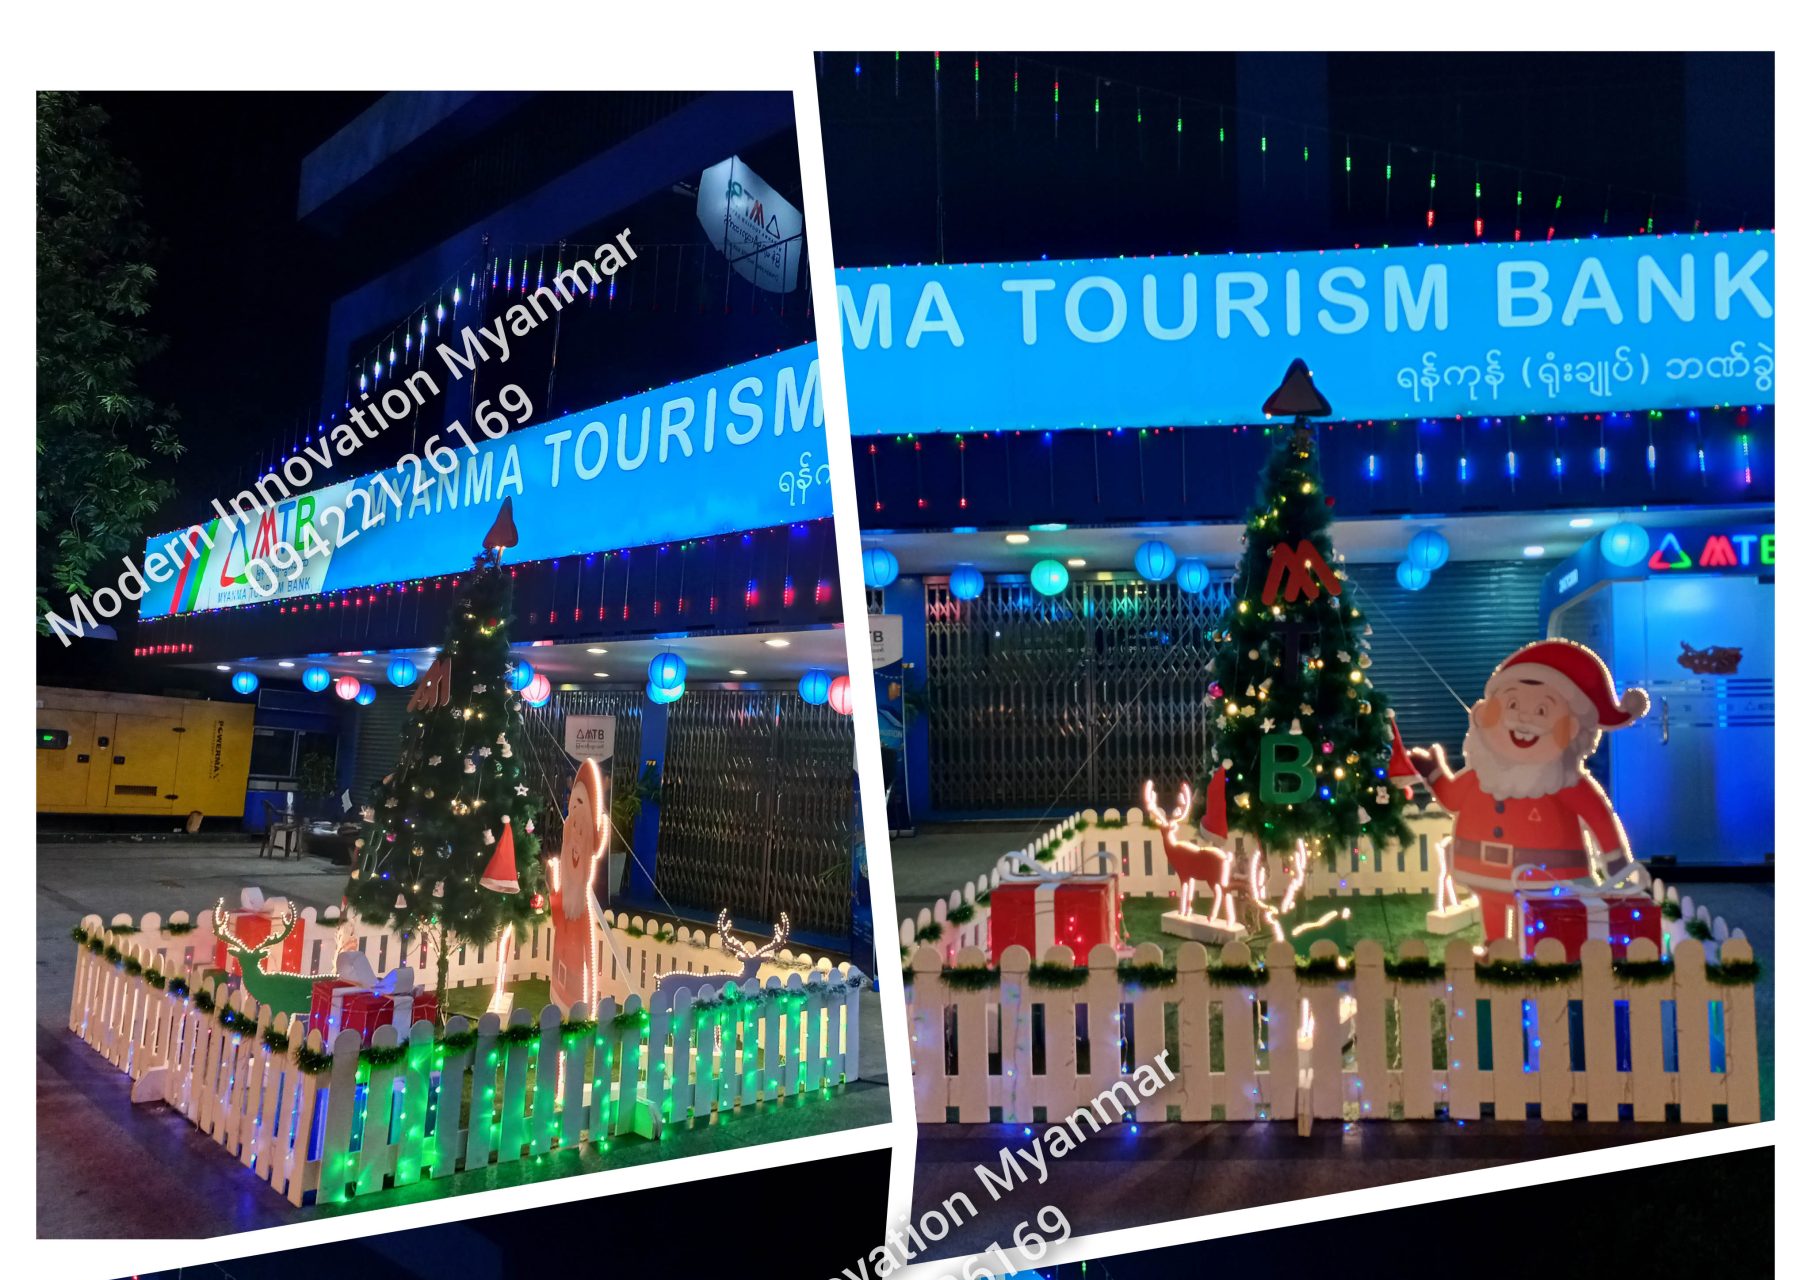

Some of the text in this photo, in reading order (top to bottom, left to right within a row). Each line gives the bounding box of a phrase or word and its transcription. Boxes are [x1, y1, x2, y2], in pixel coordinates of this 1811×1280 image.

[836, 249, 1774, 350] MA TOURISM BANK
[1396, 349, 1505, 403] ရန်ကုန်
[544, 358, 825, 488] TOURISM
[252, 496, 316, 560] MTB
[287, 577, 311, 593] BANK
[585, 729, 605, 740] MTB
[1259, 733, 1317, 804] B
